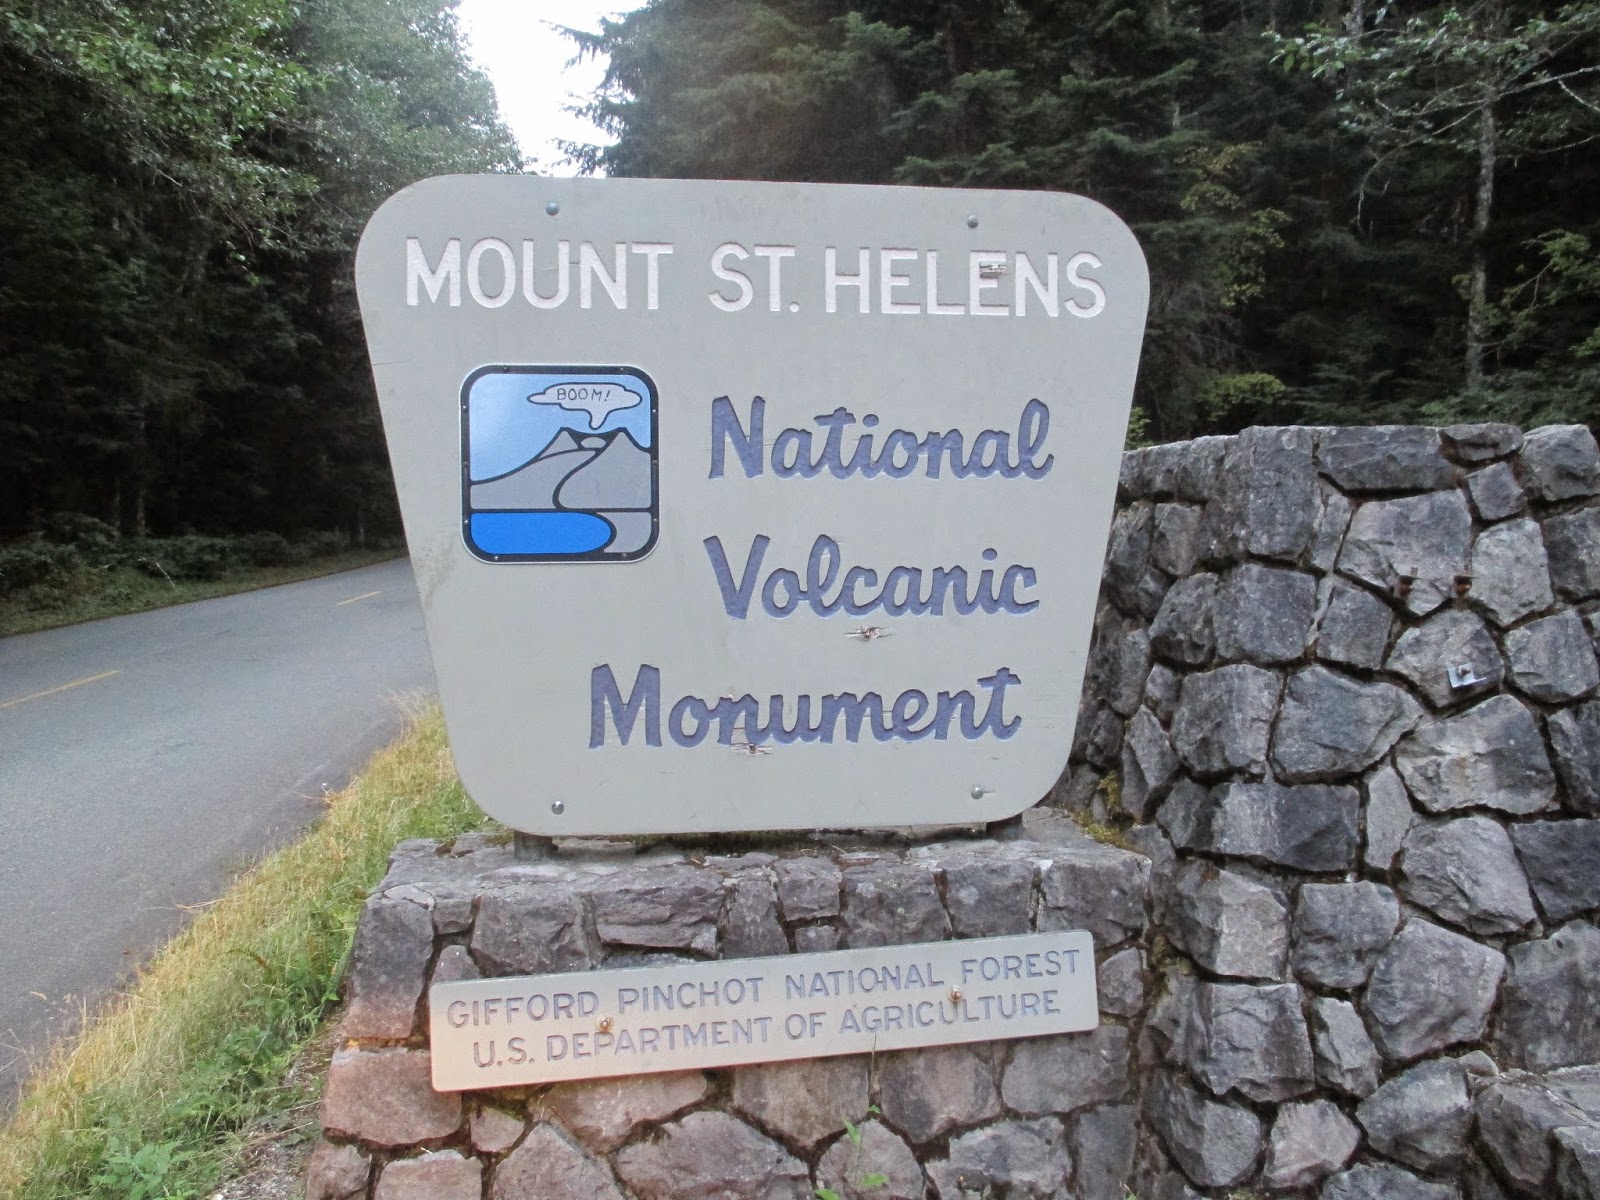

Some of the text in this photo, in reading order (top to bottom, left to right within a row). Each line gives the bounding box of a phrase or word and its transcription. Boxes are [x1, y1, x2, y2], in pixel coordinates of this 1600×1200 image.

[405, 236, 1107, 318] MOUNT ST. HELENS
[557, 388, 611, 401] BOOM!
[708, 395, 1054, 480] National
[703, 534, 1040, 620] Volcanic
[588, 664, 1023, 748] Monument
[447, 949, 1080, 1027] GIFFORD PINCHOT NATIONAL FOREST
[473, 990, 1061, 1068] U.S. DEPARTMENT OF AGRICULTURE
